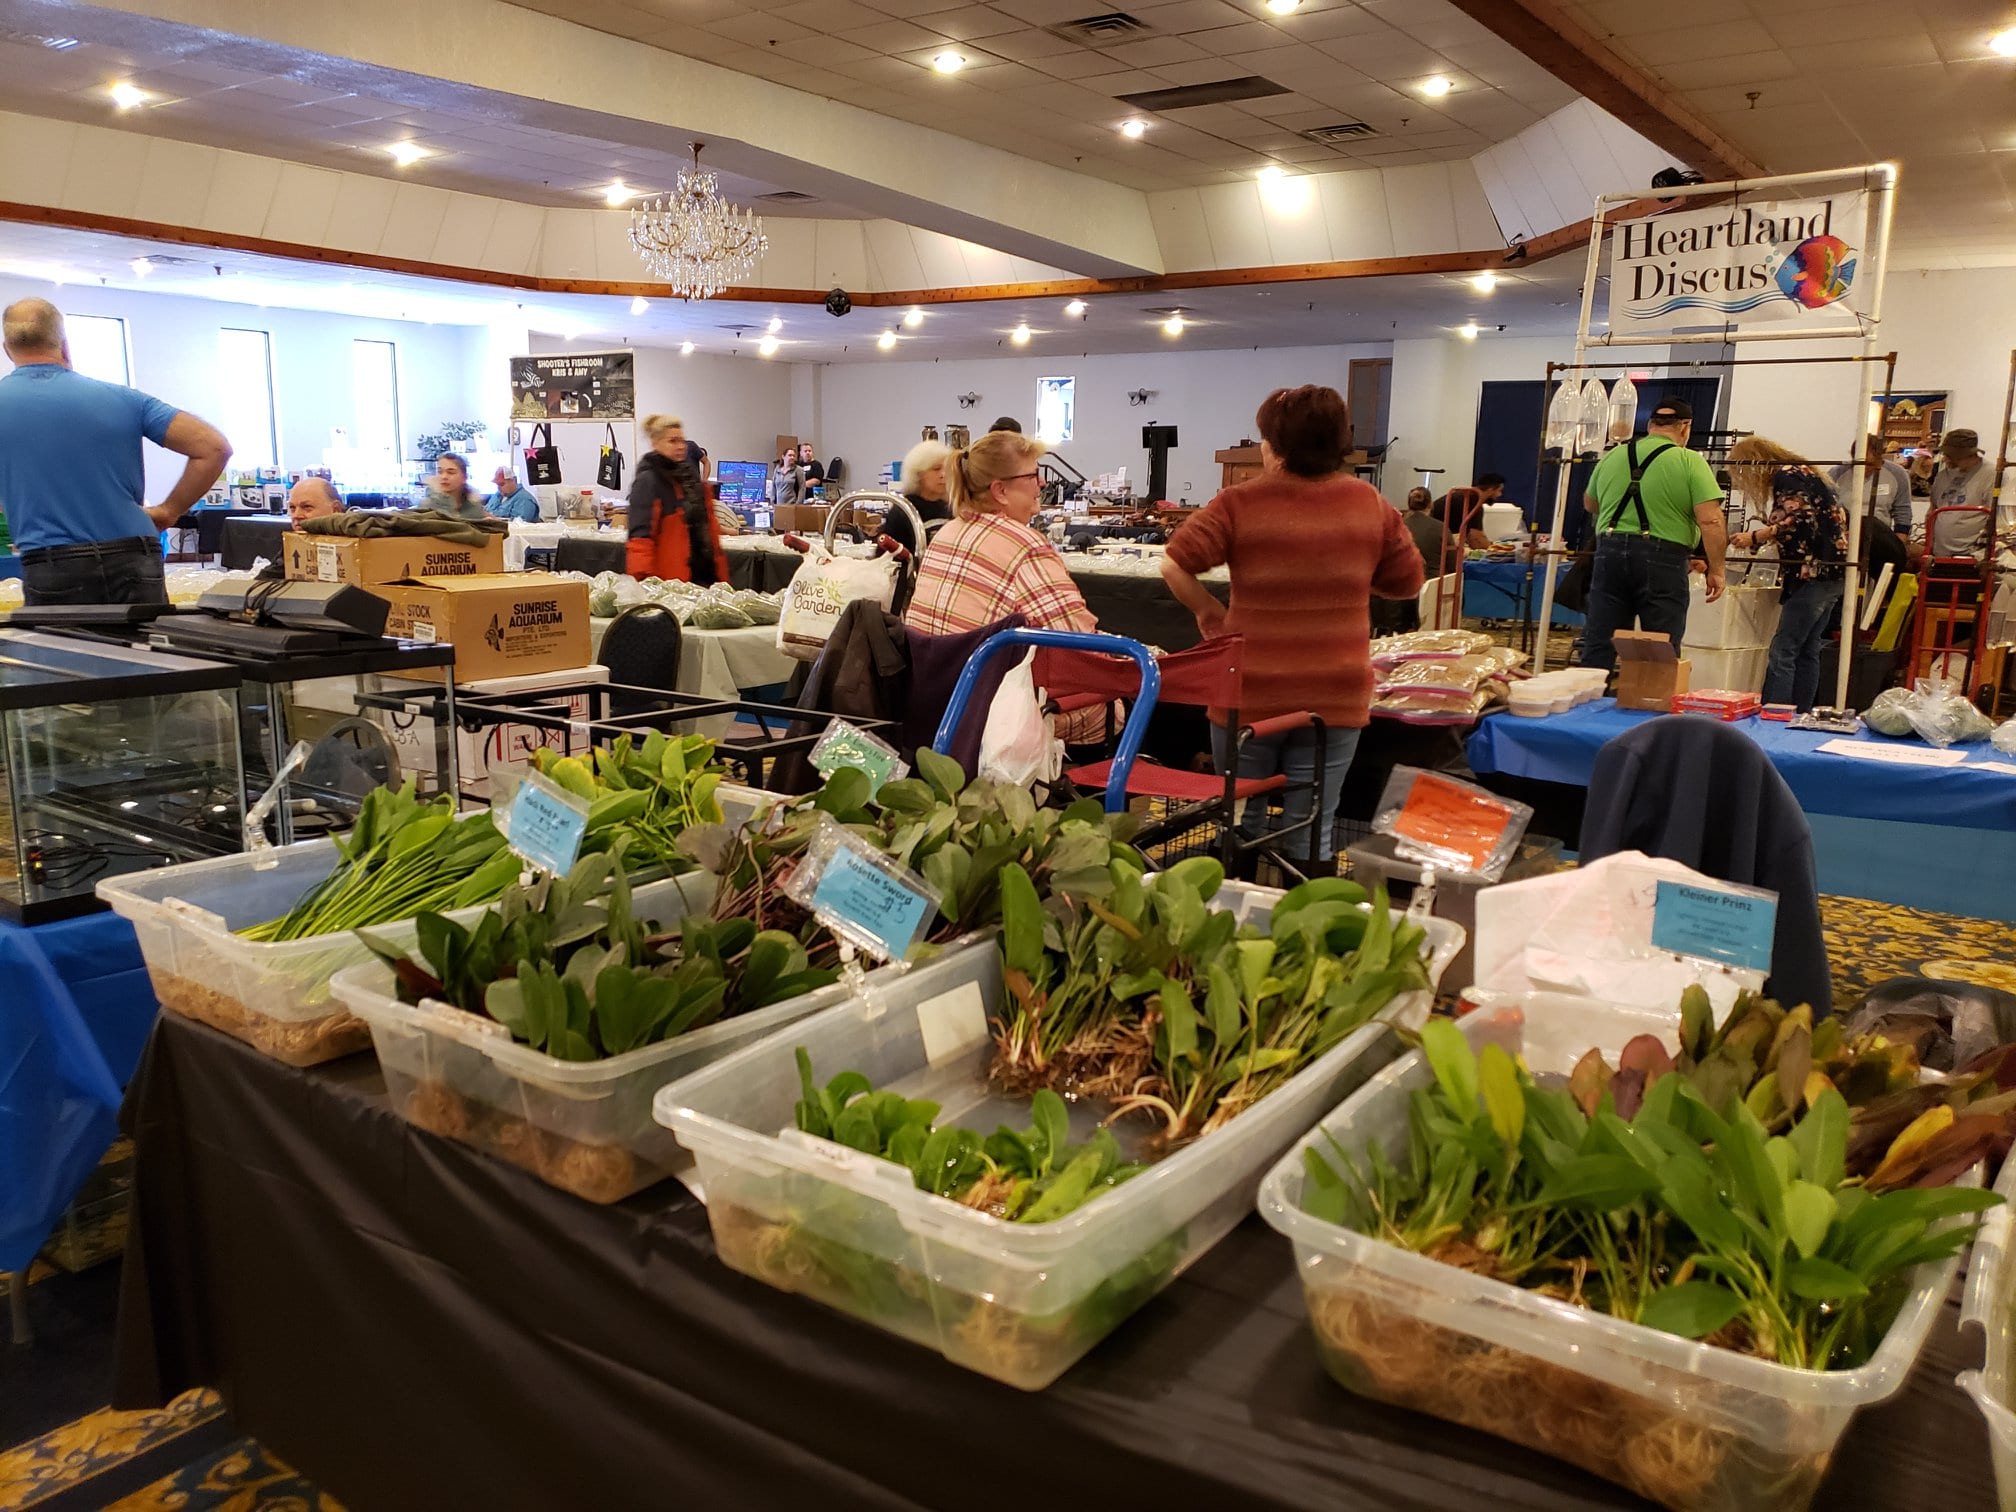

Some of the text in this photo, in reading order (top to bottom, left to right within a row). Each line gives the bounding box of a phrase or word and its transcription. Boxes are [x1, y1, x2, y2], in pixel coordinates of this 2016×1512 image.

[1617, 200, 1832, 261] Heartland
[1628, 261, 1768, 302] Discus
[537, 357, 603, 369] SHOOTER'S FISHROOM
[552, 368, 566, 377] KRIS
[574, 367, 588, 377] AMY
[425, 552, 471, 565] SUNRISE
[421, 563, 477, 577] AQUARIUM
[792, 580, 824, 598] Olive
[407, 604, 431, 619] STOCK
[513, 600, 558, 615] SUNRISE
[793, 595, 842, 617] Garden
[509, 611, 563, 629] AQUARIUM
[847, 858, 881, 886] Rosette
[881, 880, 914, 906] Sword
[1679, 888, 1753, 912] Kleiner Prinz
